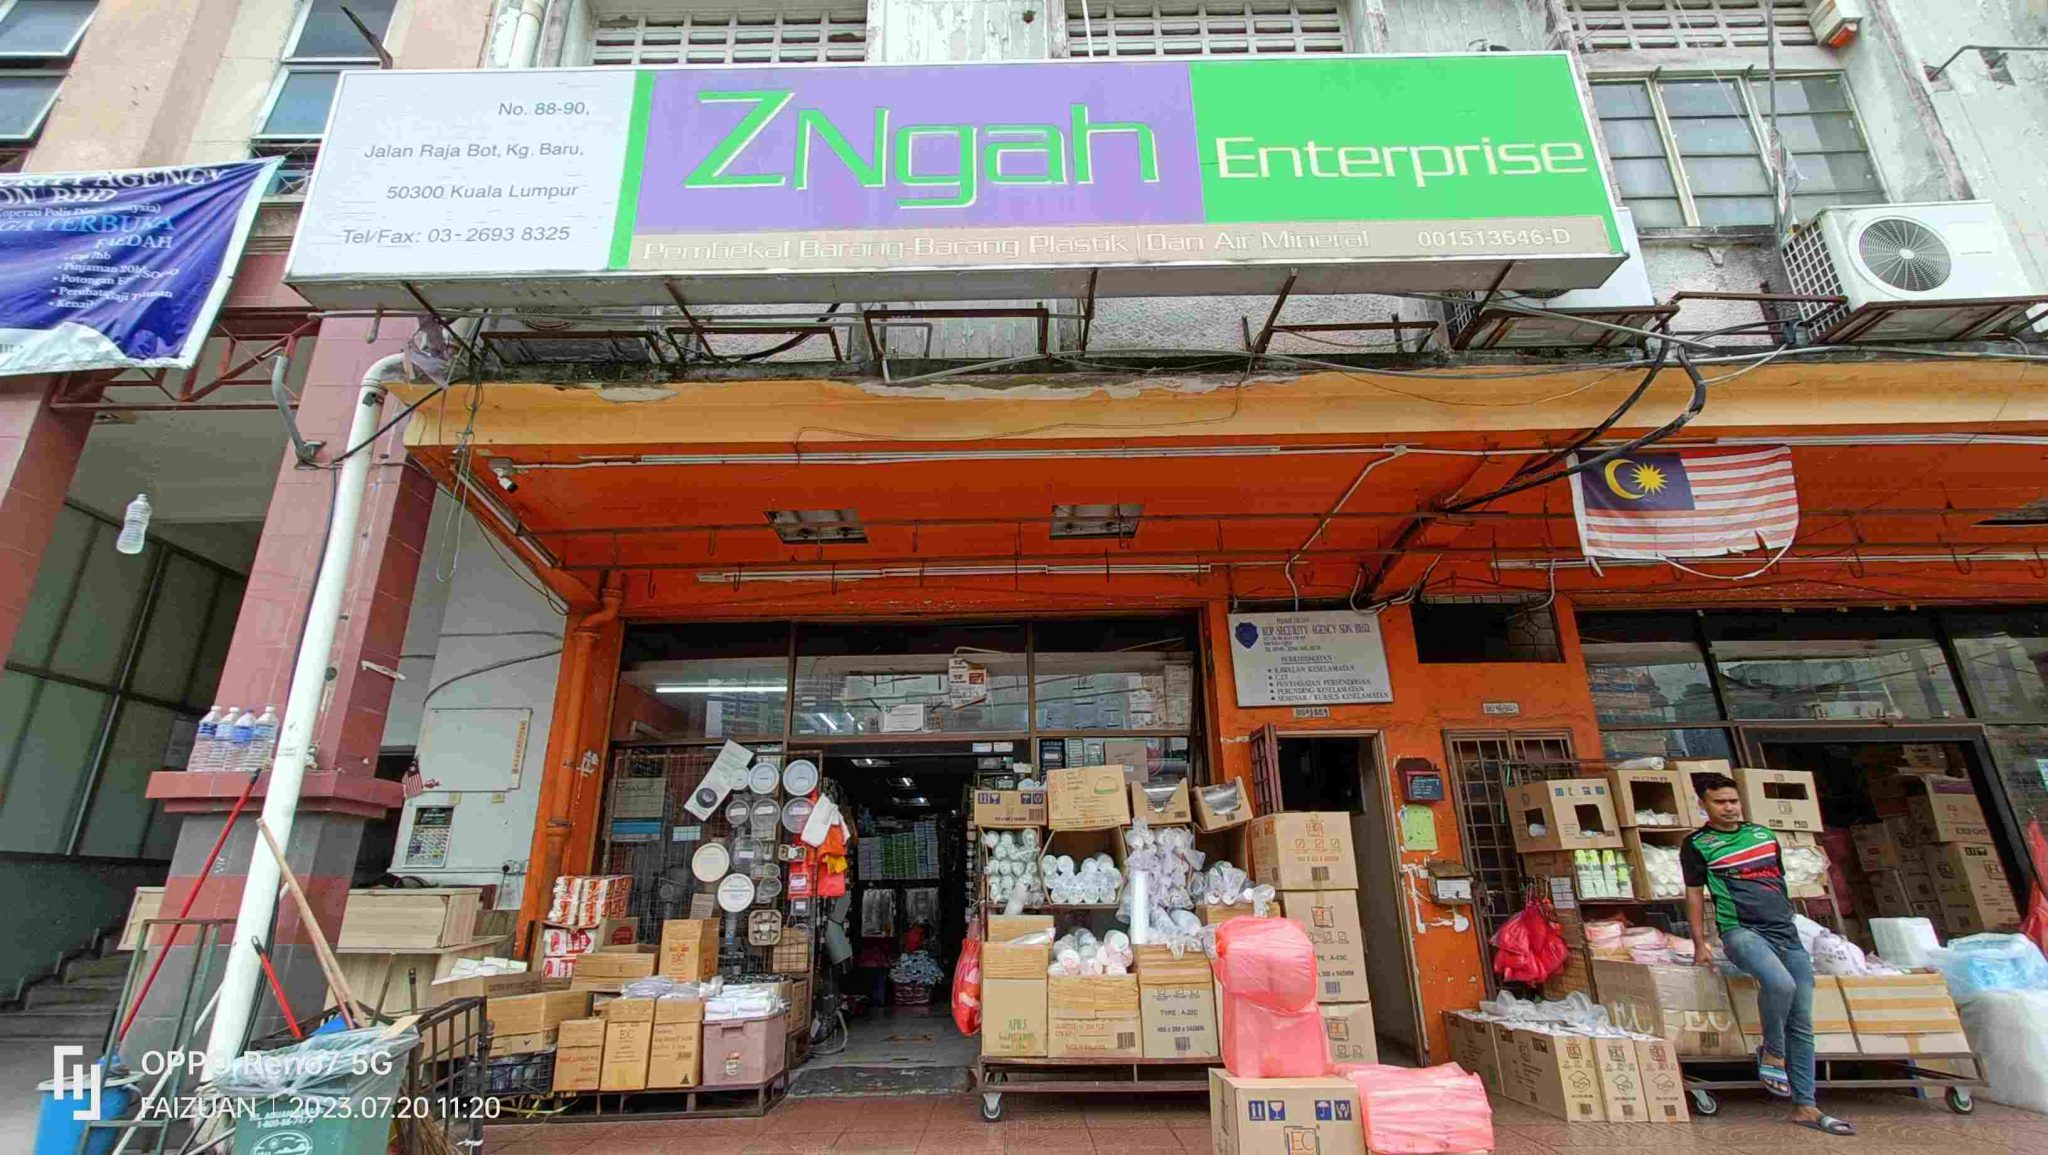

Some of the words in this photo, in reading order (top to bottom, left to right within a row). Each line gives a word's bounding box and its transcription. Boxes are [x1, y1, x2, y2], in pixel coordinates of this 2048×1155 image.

[498, 102, 528, 116] No.
[364, 144, 413, 159] Jalan
[419, 143, 461, 160] Raja
[466, 143, 501, 158] Bot,
[506, 143, 535, 160] Kg.
[684, 90, 1160, 209] ZNgah
[1215, 137, 1588, 188] Enterprise
[386, 185, 444, 199] 50300
[450, 184, 502, 199] Kuala
[509, 183, 579, 200] Lumpur
[342, 229, 421, 244] Tel/Fax:
[521, 227, 571, 241] 8325
[643, 240, 790, 259] Pembekal
[799, 234, 1019, 260] Barang-Barang
[1029, 234, 1128, 253] Plastik
[1147, 233, 1203, 250] Dan
[1215, 231, 1251, 249] Air
[1262, 229, 1369, 248] Mineral
[1418, 229, 1571, 247] 001513646-D
